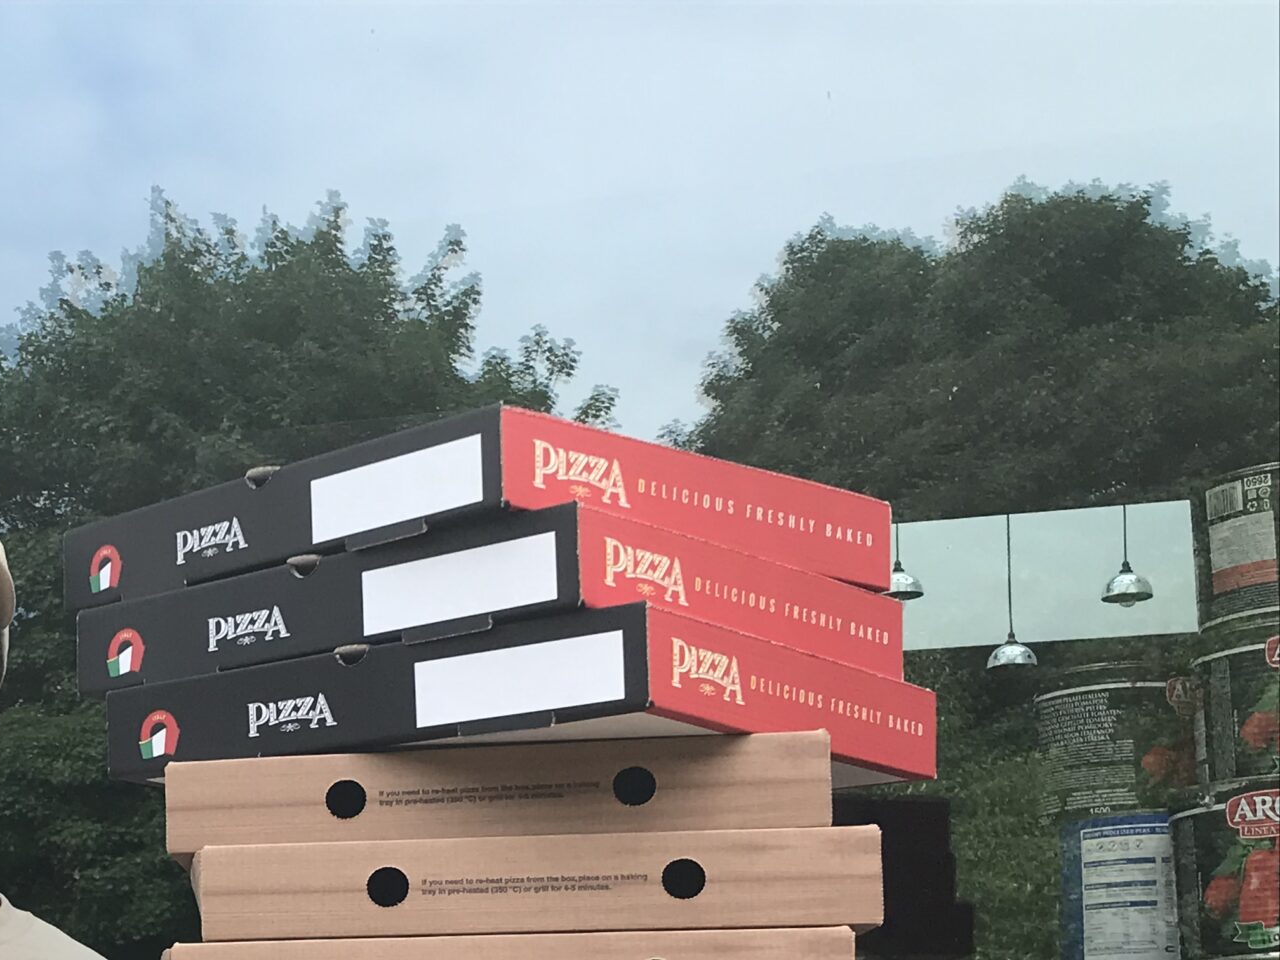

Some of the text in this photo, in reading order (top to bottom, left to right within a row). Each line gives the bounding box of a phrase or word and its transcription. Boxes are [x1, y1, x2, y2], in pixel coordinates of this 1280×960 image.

[533, 439, 873, 547] PIZZA DELICIOUS FRESHLY BAKED
[176, 516, 248, 565] PIZZA
[208, 605, 290, 652] PIZZA
[604, 537, 890, 646] PIZZA DELICIOUS FRESHLY BAKED
[247, 692, 337, 737] PIZZA
[671, 637, 924, 737] PIZZA DELICIOUS FRESHLY BAKED
